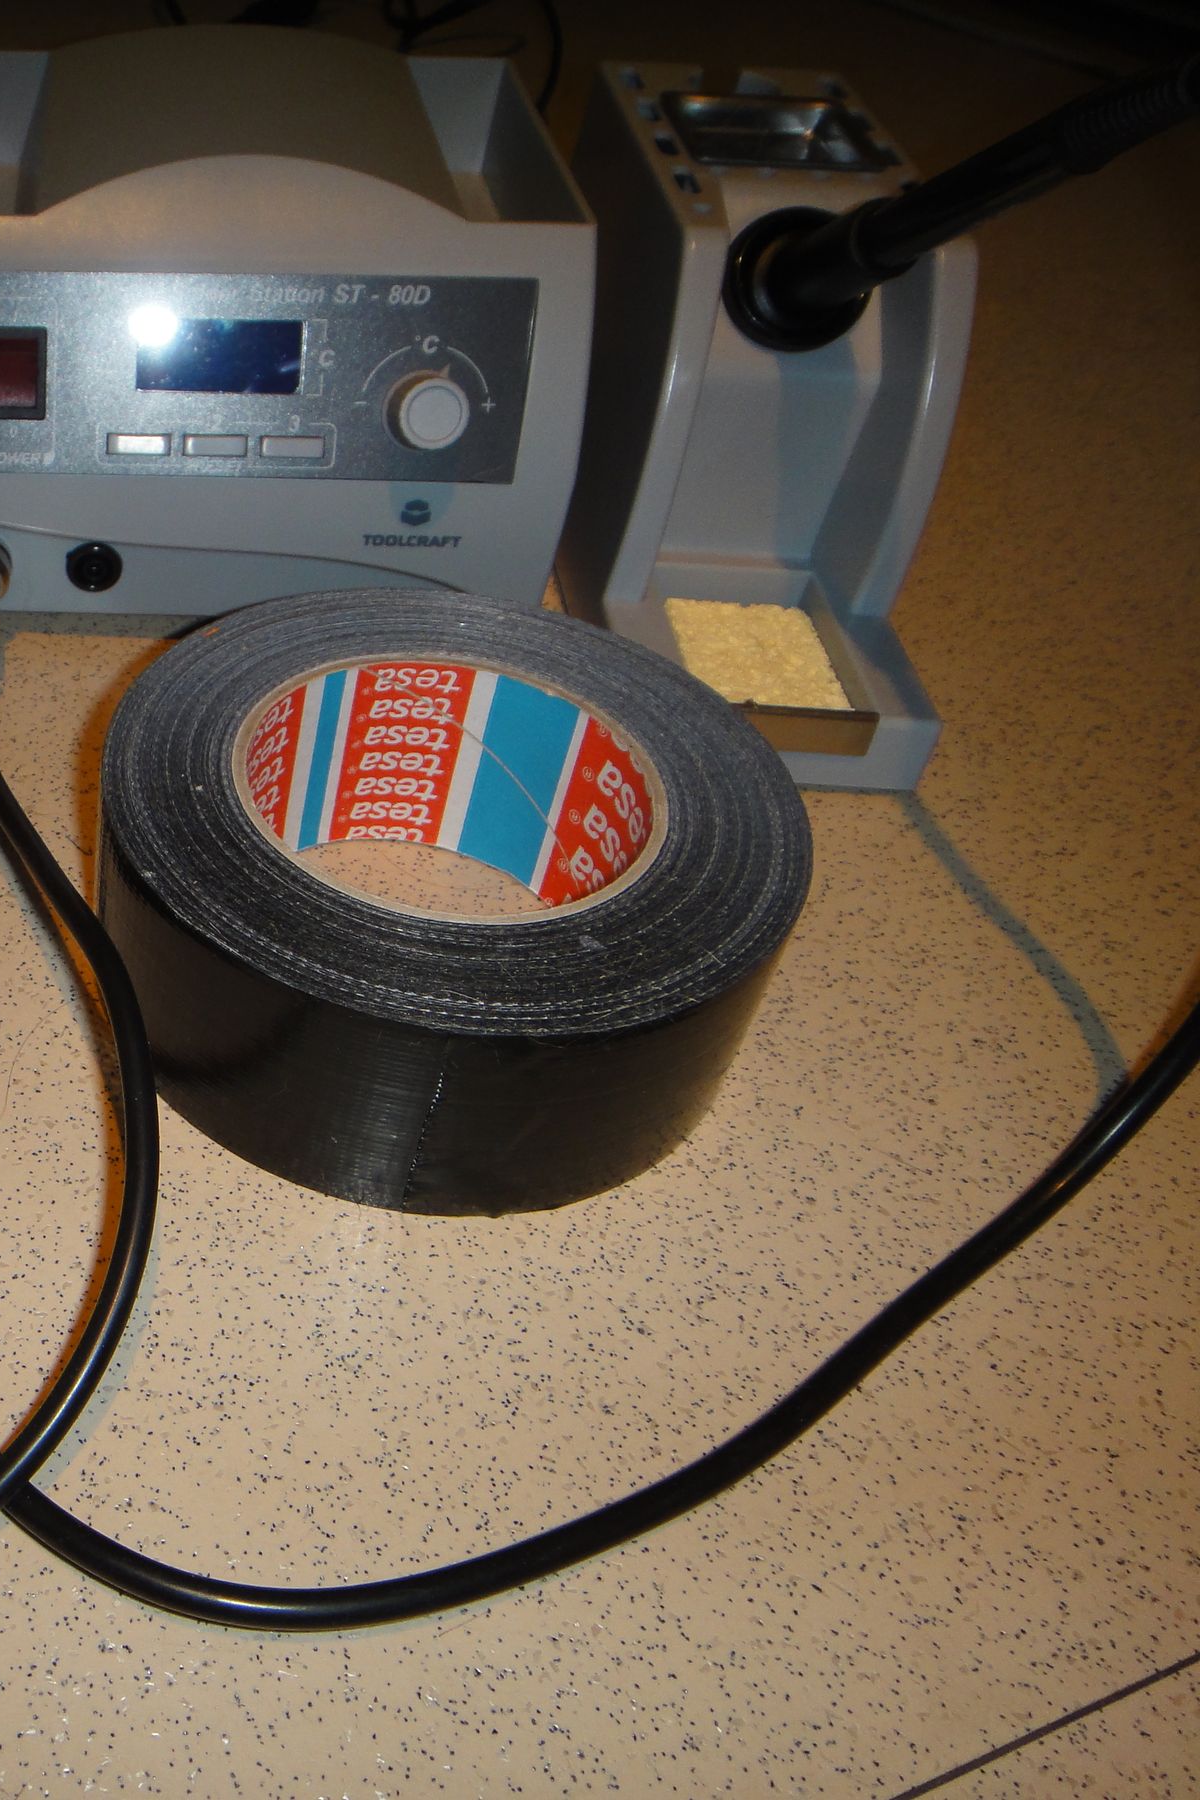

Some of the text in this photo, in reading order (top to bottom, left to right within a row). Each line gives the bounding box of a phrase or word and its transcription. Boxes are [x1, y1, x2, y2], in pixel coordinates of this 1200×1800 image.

[333, 284, 366, 304] ST
[388, 284, 432, 305] 80D
[362, 534, 462, 548] TOOLCRAFT
[374, 667, 462, 693] tesa
[369, 697, 455, 724] tesa
[363, 725, 450, 750] tesa
[358, 751, 445, 776] tesa
[353, 776, 438, 801] tesa
[349, 801, 433, 826] tesa
[597, 759, 646, 844] esa
